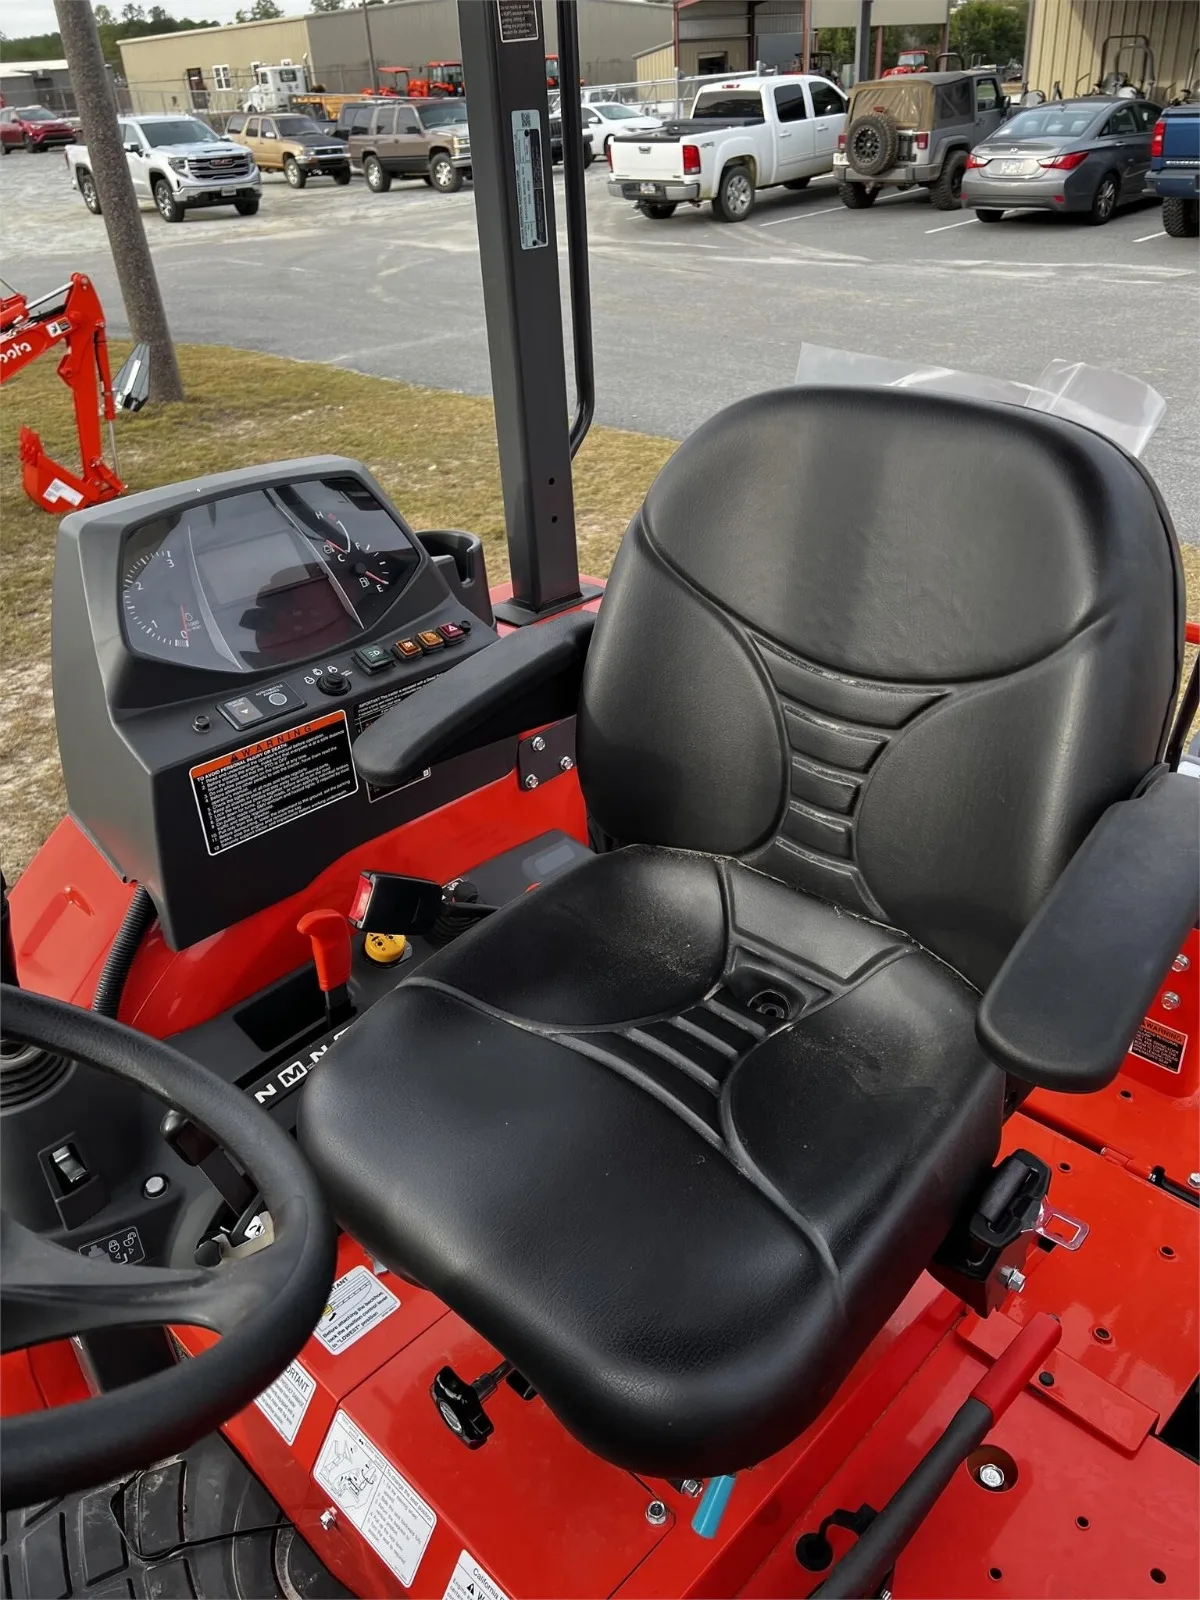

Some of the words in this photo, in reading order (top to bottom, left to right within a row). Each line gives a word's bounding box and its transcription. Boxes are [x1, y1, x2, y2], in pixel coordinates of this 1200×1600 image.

[314, 511, 324, 519] H
[166, 559, 174, 568] 3
[337, 554, 346, 562] C
[135, 582, 144, 590] 2
[242, 724, 311, 757] WARNING
[204, 769, 220, 778] AVOID
[220, 759, 245, 772] PERSONAL
[246, 752, 262, 762] INJURY
[1145, 1021, 1182, 1042] WARNING
[254, 1083, 277, 1104] N
[322, 1324, 338, 1338] Before
[337, 1309, 358, 1327] attaching
[356, 1304, 365, 1312] the
[327, 1333, 337, 1344] lock
[336, 1327, 345, 1336] the
[344, 1314, 363, 1330] position
[361, 1303, 378, 1317] control
[376, 1295, 388, 1305] lever
[473, 1566, 500, 1600] California
